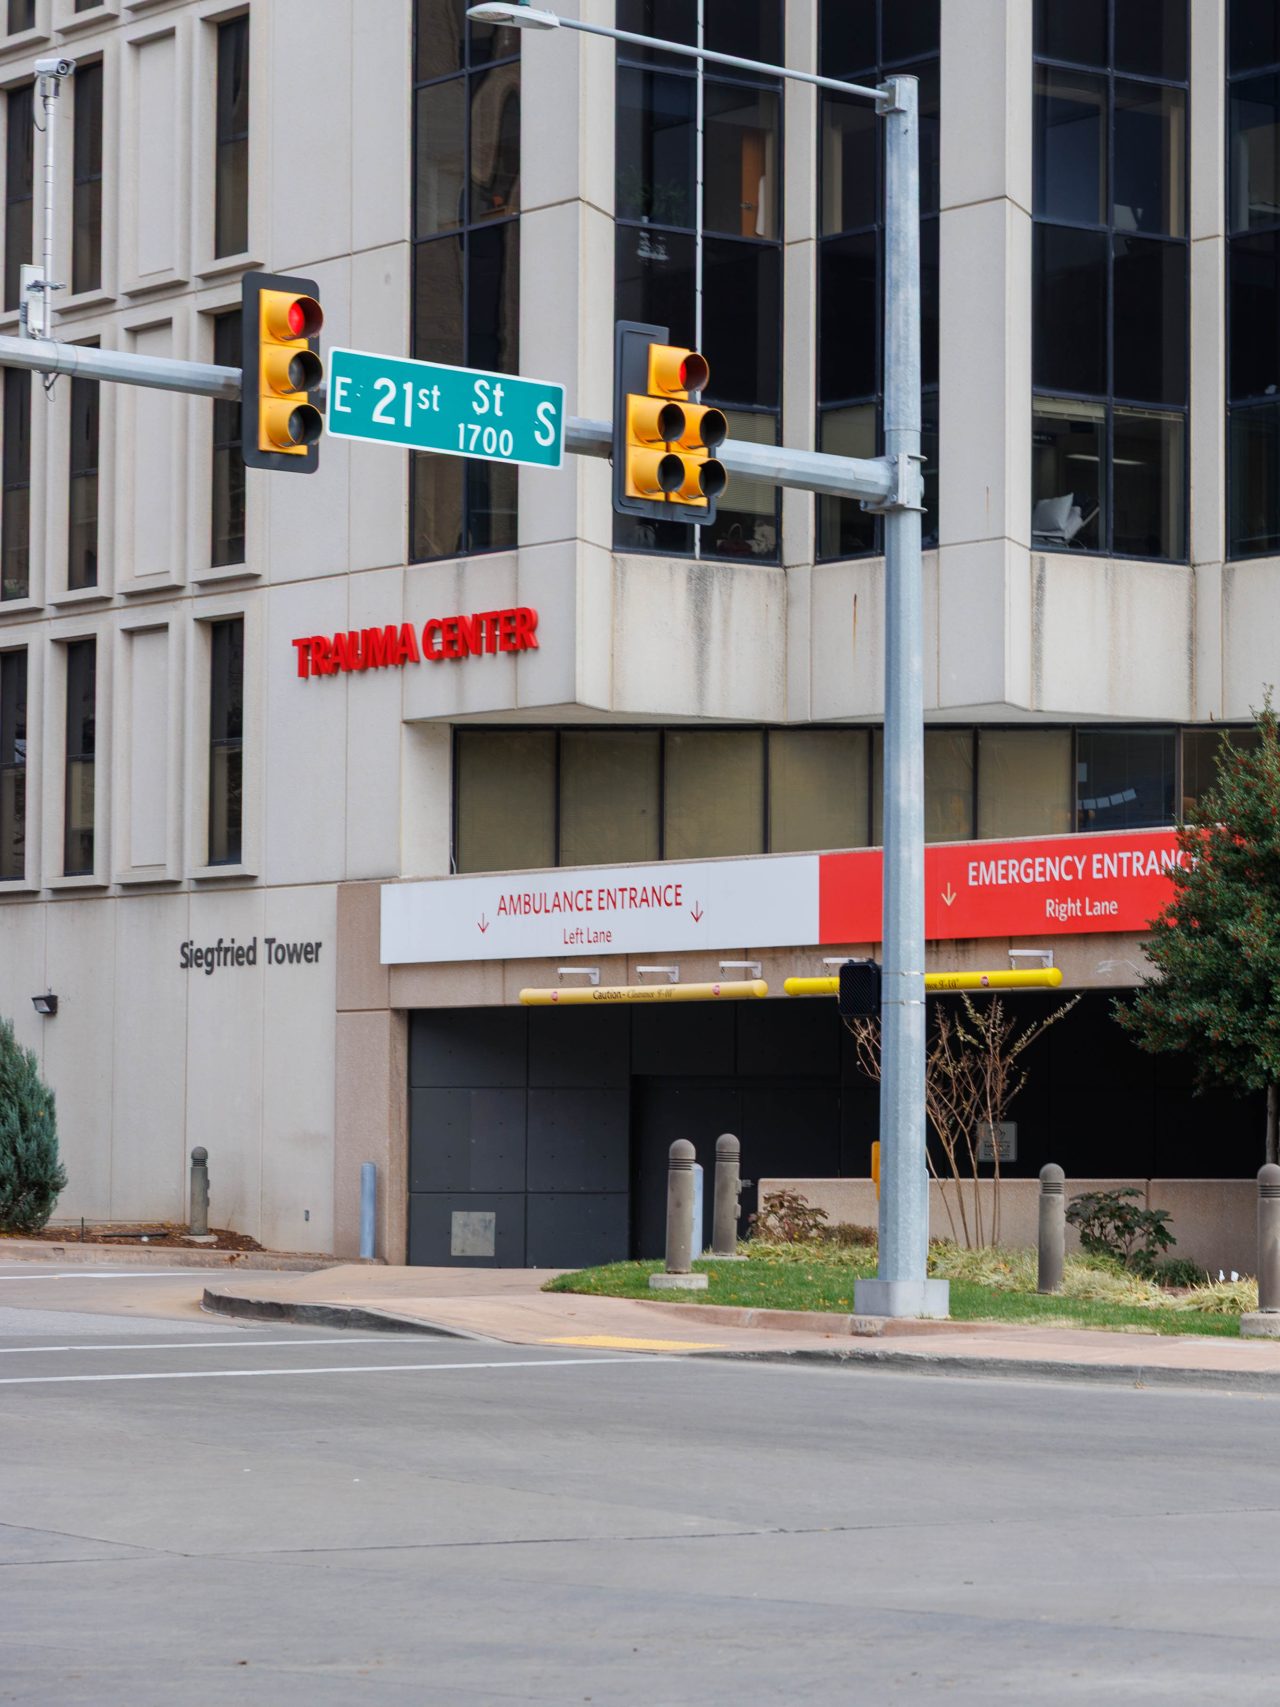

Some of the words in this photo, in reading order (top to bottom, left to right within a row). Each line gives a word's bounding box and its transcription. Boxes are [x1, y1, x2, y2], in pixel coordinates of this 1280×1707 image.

[334, 375, 352, 413] E
[371, 377, 441, 428] 21st
[471, 379, 504, 417] St
[533, 401, 557, 447] S
[458, 422, 514, 457] 1700
[292, 623, 420, 678] TRAUMA
[421, 607, 539, 661] CENTER
[968, 855, 1087, 886] EMERGENCY
[1092, 848, 1200, 880] ENTRANC
[497, 889, 593, 916] AMBULANCE
[597, 884, 683, 911] ENTRANCE
[1045, 898, 1082, 922] Right
[1085, 897, 1118, 916] Lane
[563, 927, 584, 945] Left
[587, 927, 612, 944] Lane
[180, 936, 257, 975] Siegfried
[264, 937, 322, 965] Tower
